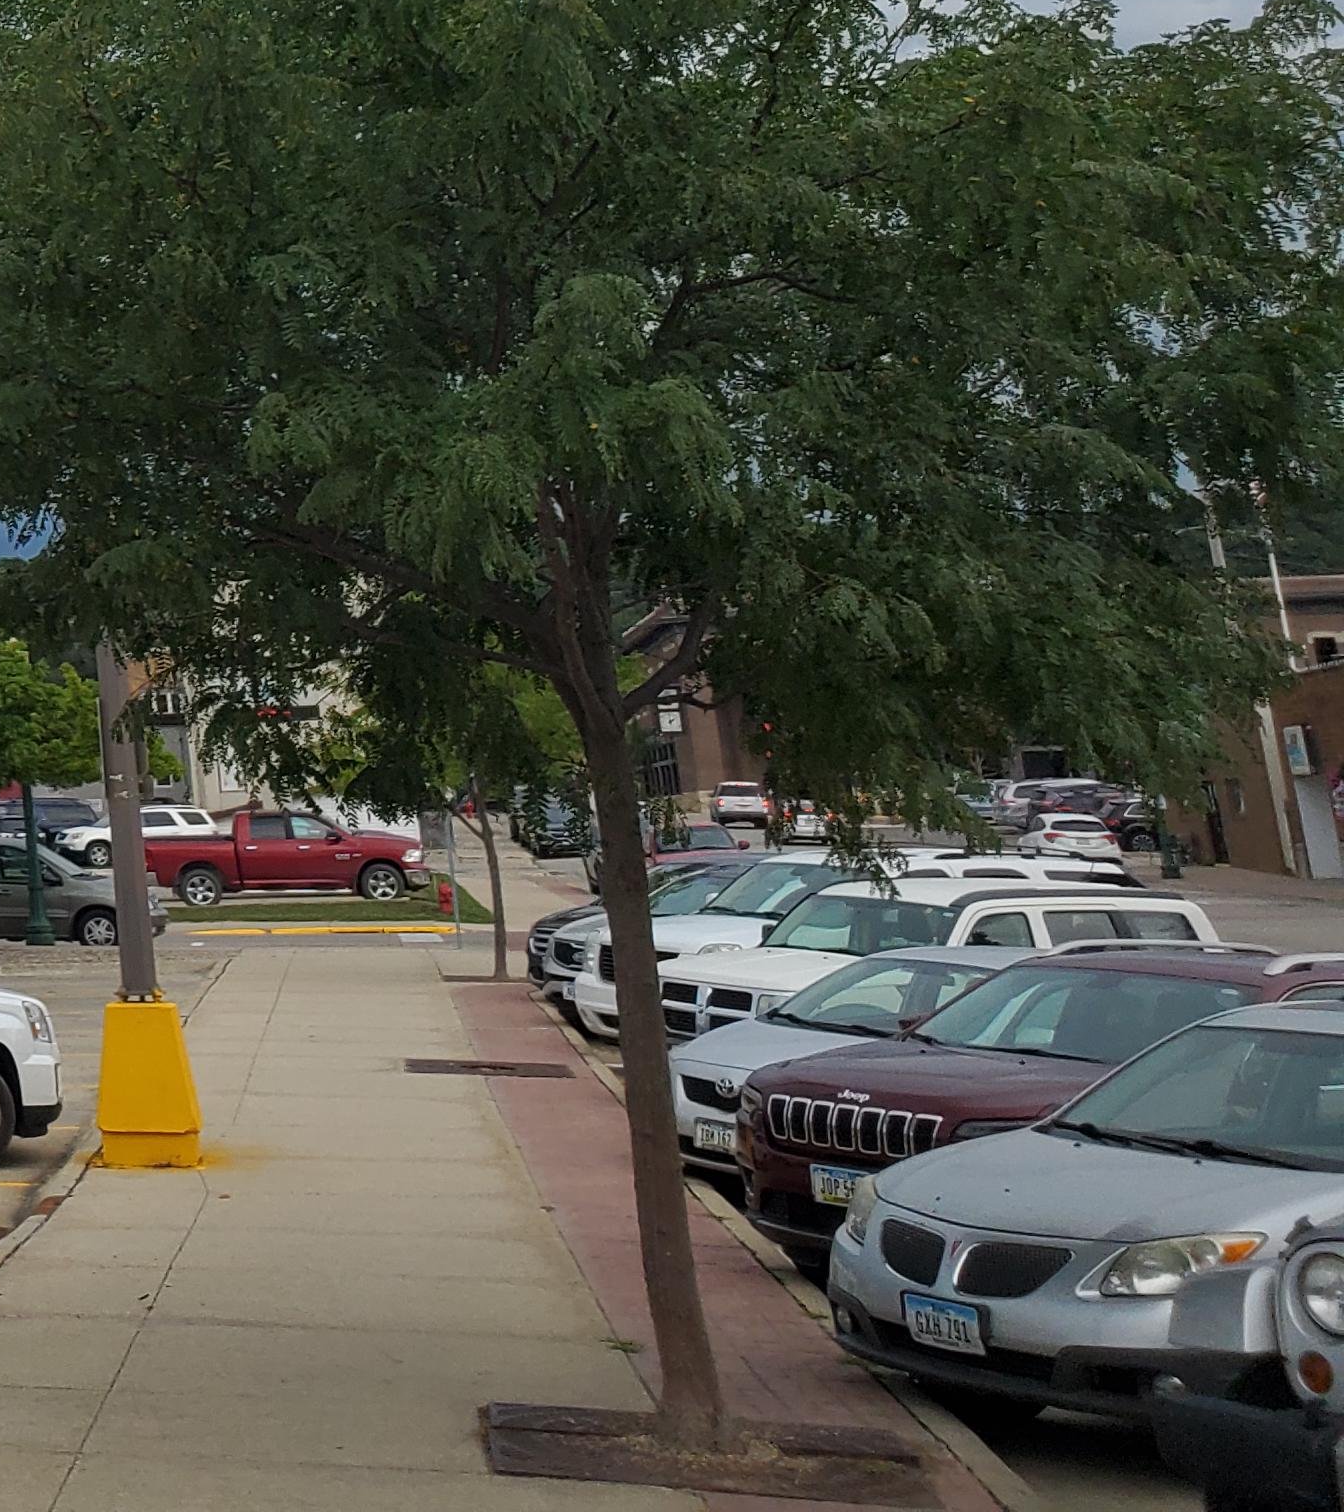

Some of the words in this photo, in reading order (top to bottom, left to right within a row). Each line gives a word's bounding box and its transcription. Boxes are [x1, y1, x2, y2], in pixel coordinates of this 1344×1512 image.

[837, 1089, 870, 1103] Jeep
[915, 1310, 942, 1337] GXH
[944, 1316, 971, 1343] 791
